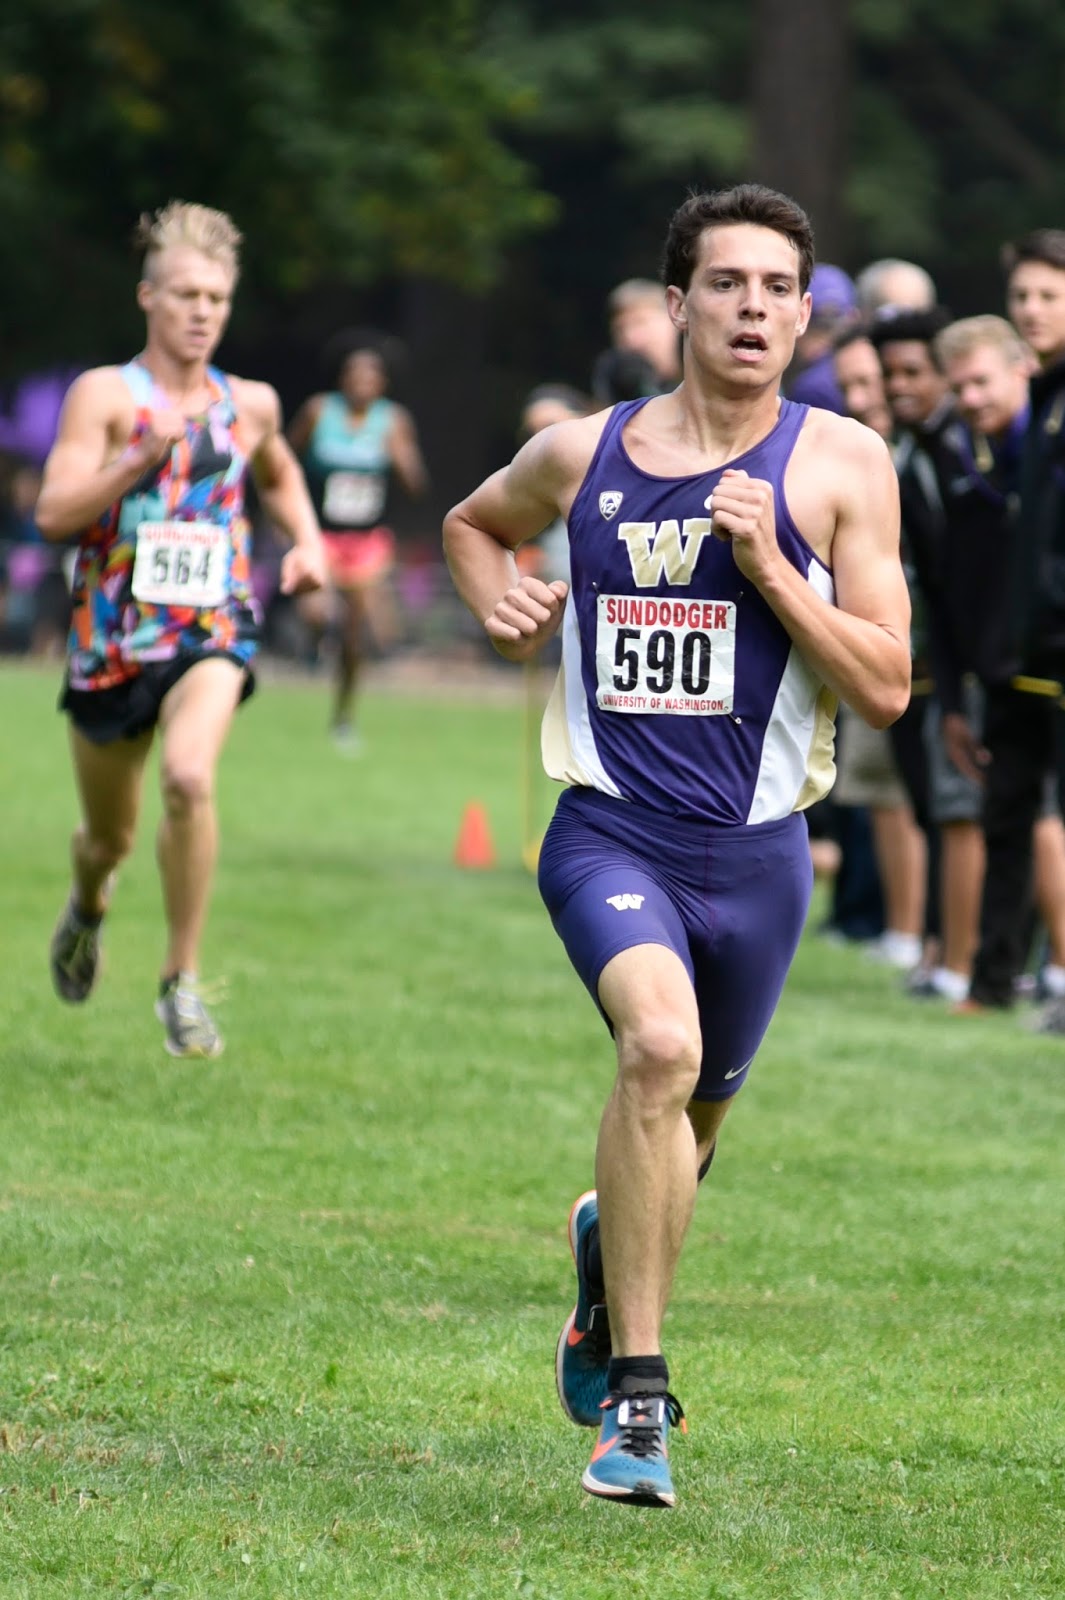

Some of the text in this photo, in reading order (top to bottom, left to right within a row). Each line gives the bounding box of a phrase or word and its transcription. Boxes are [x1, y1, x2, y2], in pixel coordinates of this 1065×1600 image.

[602, 502, 615, 514] 12
[153, 546, 211, 586] 564
[618, 518, 711, 588] W
[606, 598, 728, 629] SUNDODGER
[613, 628, 711, 695] 590
[602, 694, 724, 711] UNIVERSITY OF WASHINGTON
[606, 894, 645, 911] W
